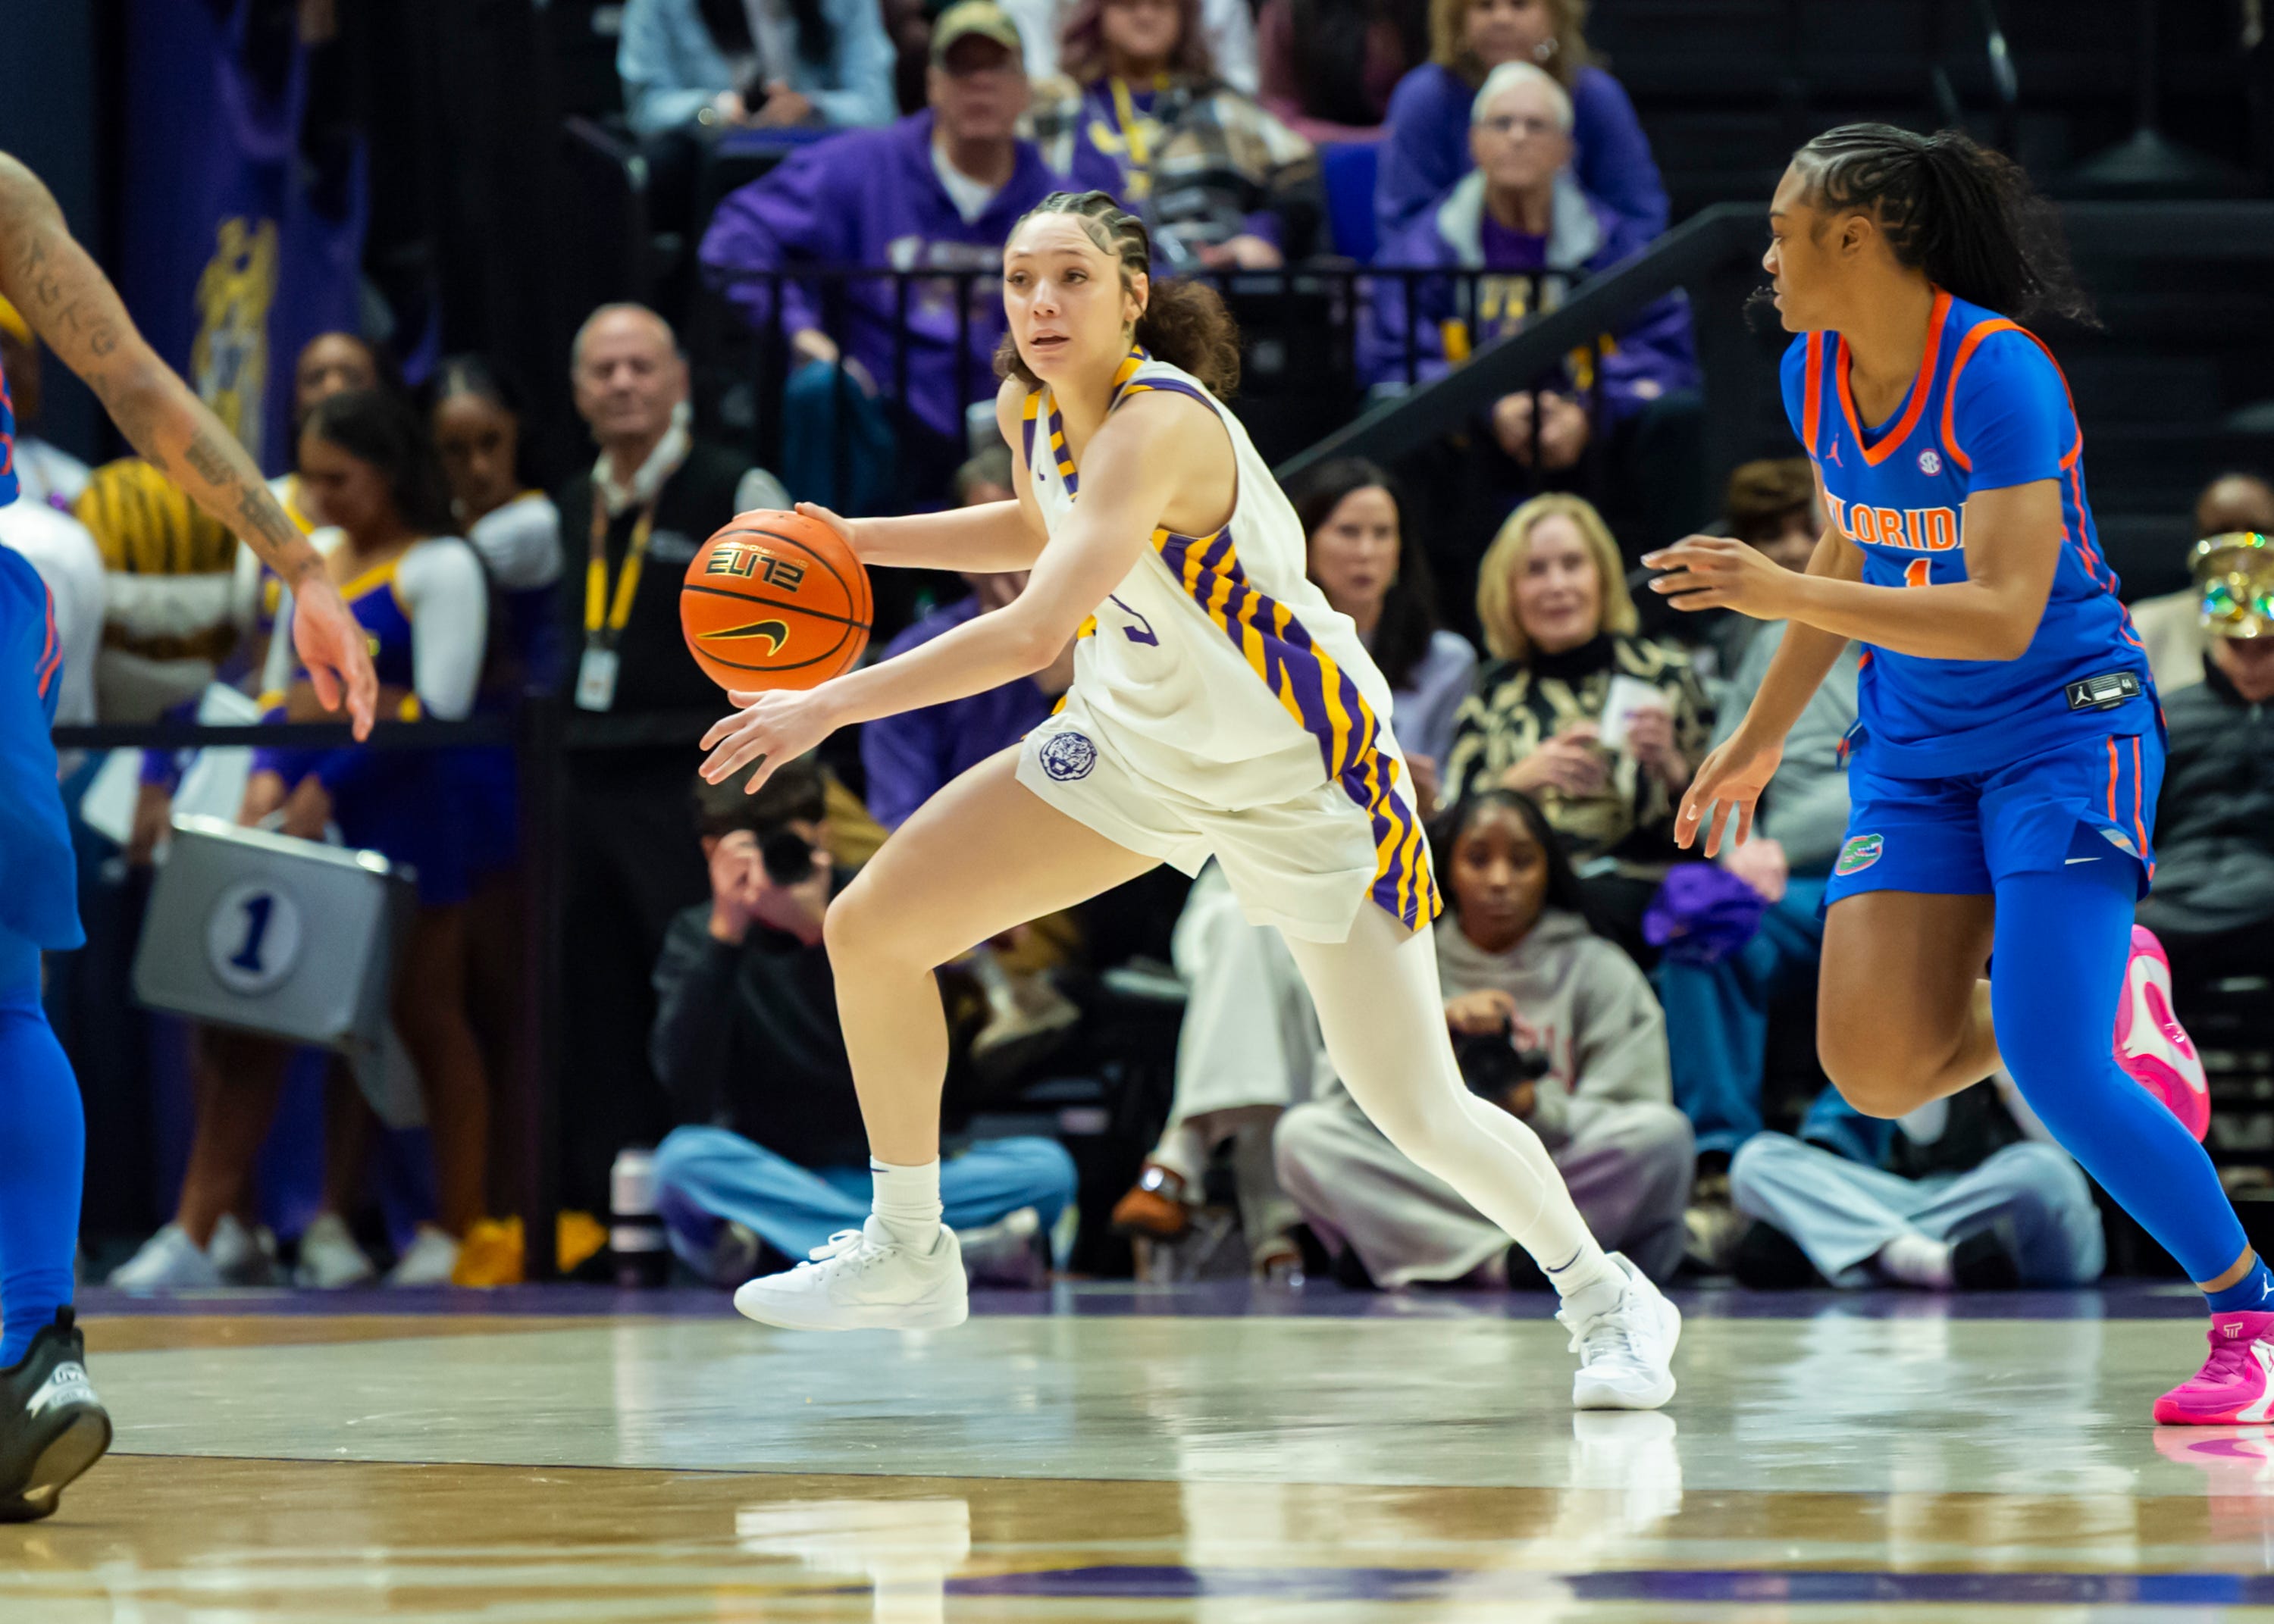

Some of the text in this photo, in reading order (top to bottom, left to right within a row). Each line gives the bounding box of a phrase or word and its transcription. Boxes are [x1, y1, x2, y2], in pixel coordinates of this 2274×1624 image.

[1824, 487, 1966, 552] LORID
[704, 549, 805, 593] ELITE
[230, 894, 273, 972] 1
